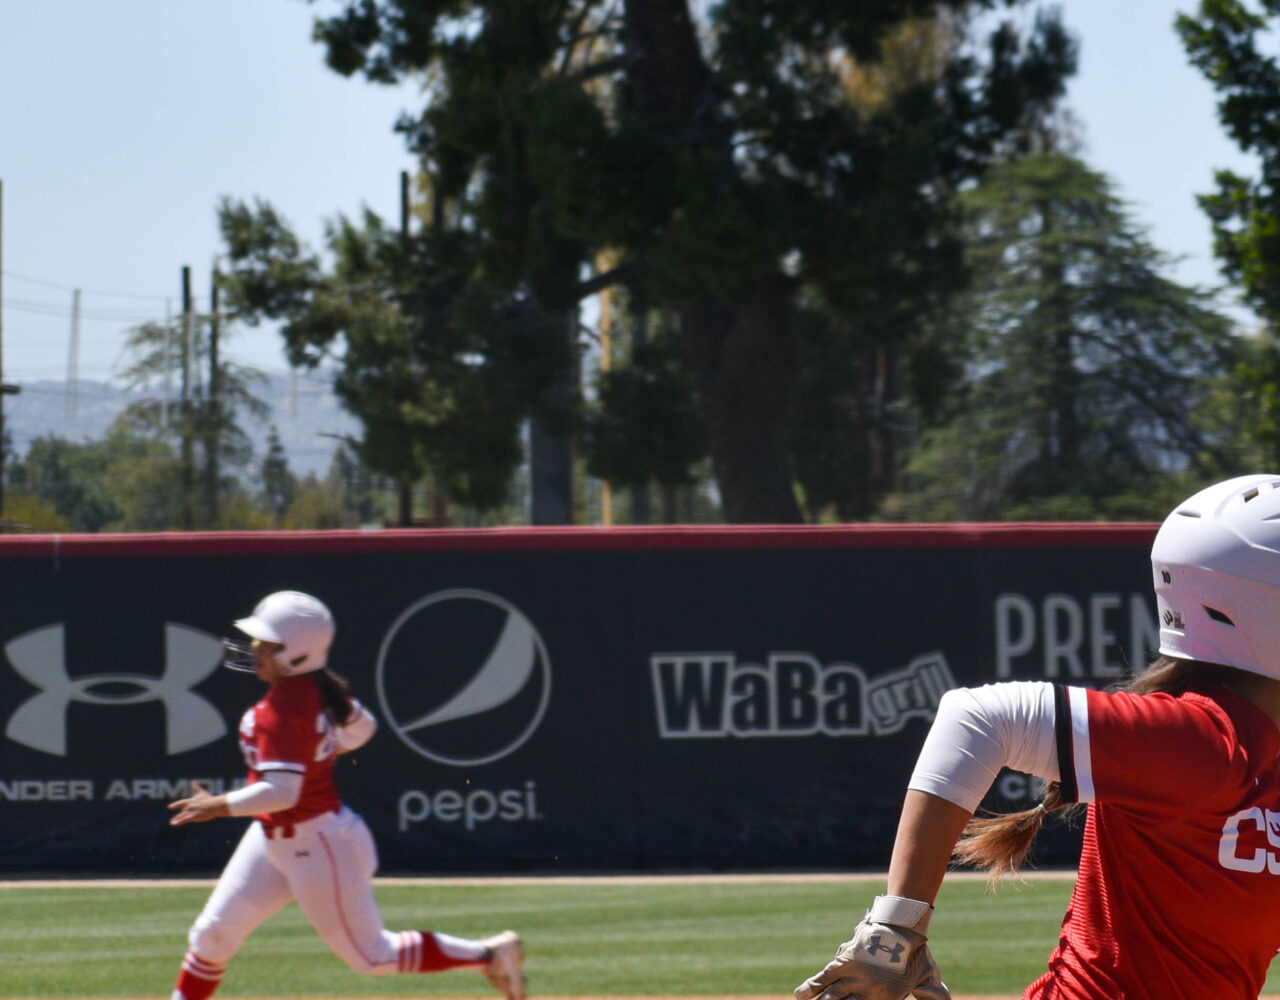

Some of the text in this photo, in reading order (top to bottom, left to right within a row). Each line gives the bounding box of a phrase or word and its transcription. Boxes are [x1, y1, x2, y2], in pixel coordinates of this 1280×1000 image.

[651, 654, 954, 737] WaBa grill
[399, 781, 537, 831] pepsi
